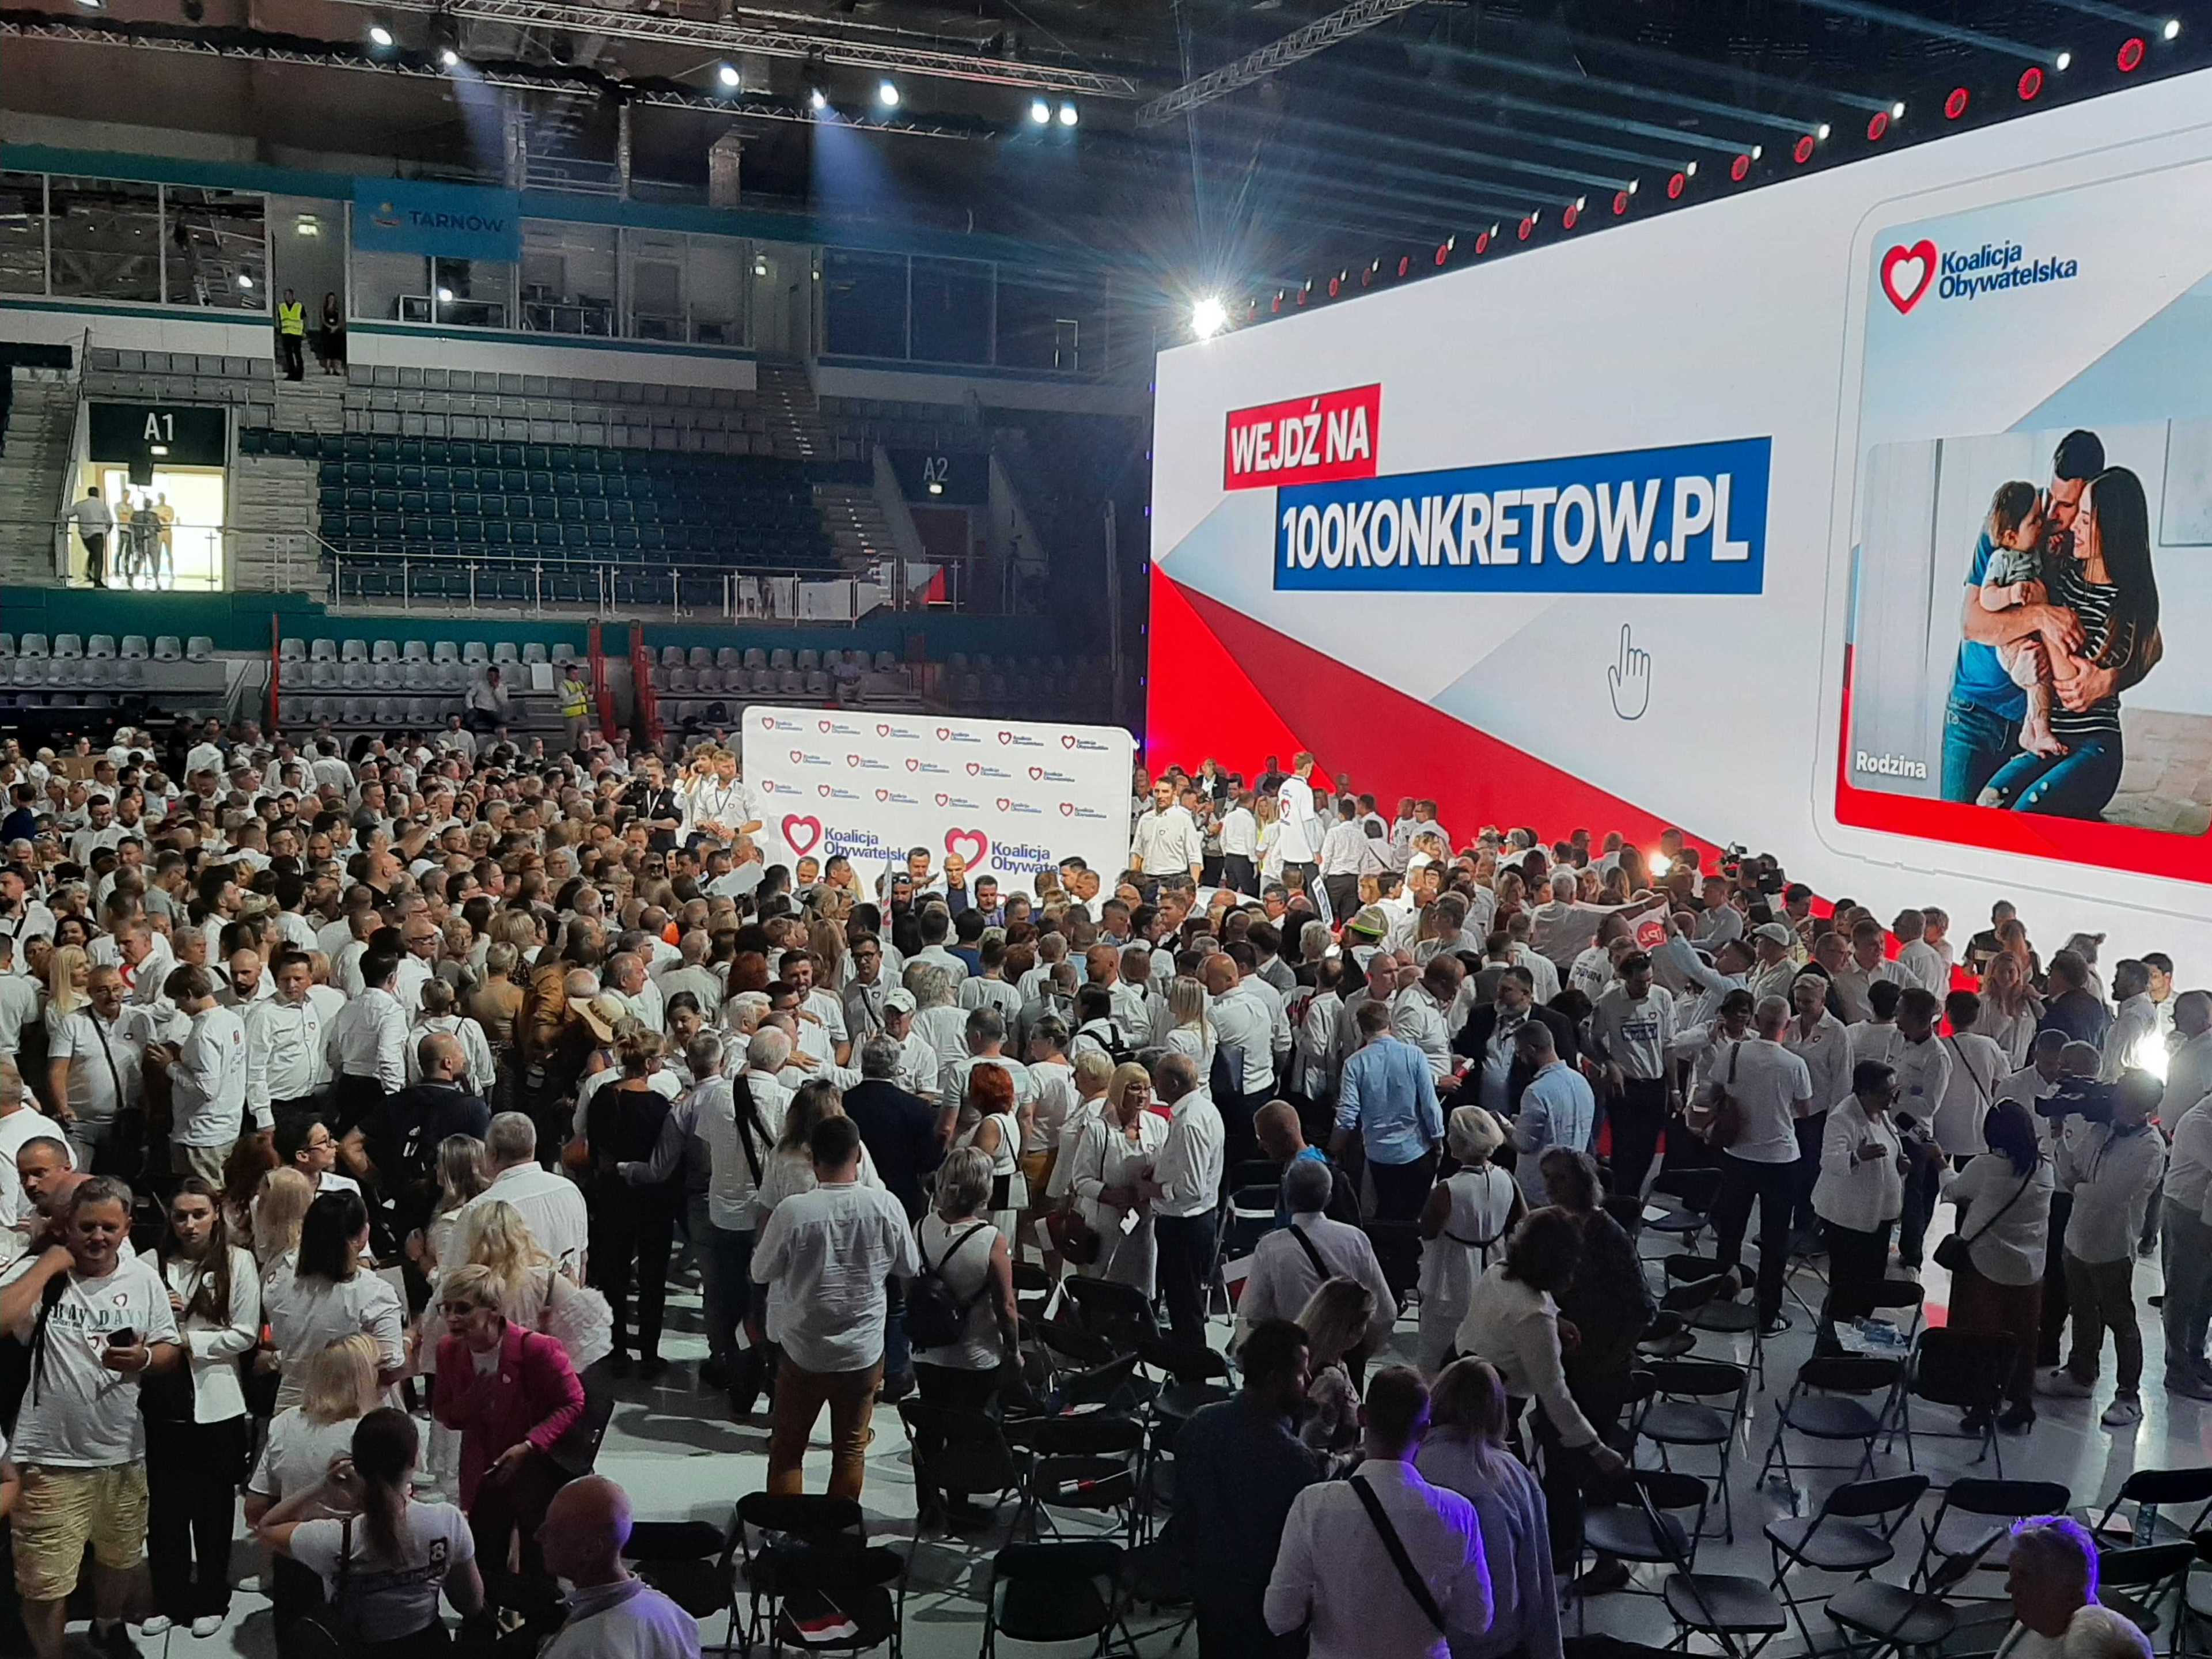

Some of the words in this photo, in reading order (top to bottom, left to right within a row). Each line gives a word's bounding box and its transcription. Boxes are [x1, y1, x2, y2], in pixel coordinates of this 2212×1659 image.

[1941, 240, 2022, 276] Koalicja
[1939, 256, 2078, 300] Obywatelska
[143, 412, 173, 441] A1
[1231, 397, 1323, 475] WEJDŹ
[1325, 406, 1370, 464] NA
[923, 457, 948, 482] A2
[1282, 472, 1750, 569] 100KONKRETOW.PL
[1856, 751, 1927, 779] Rodzina
[824, 827, 878, 847] Koalicja
[991, 840, 1050, 862] Koalicja
[824, 841, 908, 862] Obywatelsk
[991, 856, 1060, 875] Obywate
